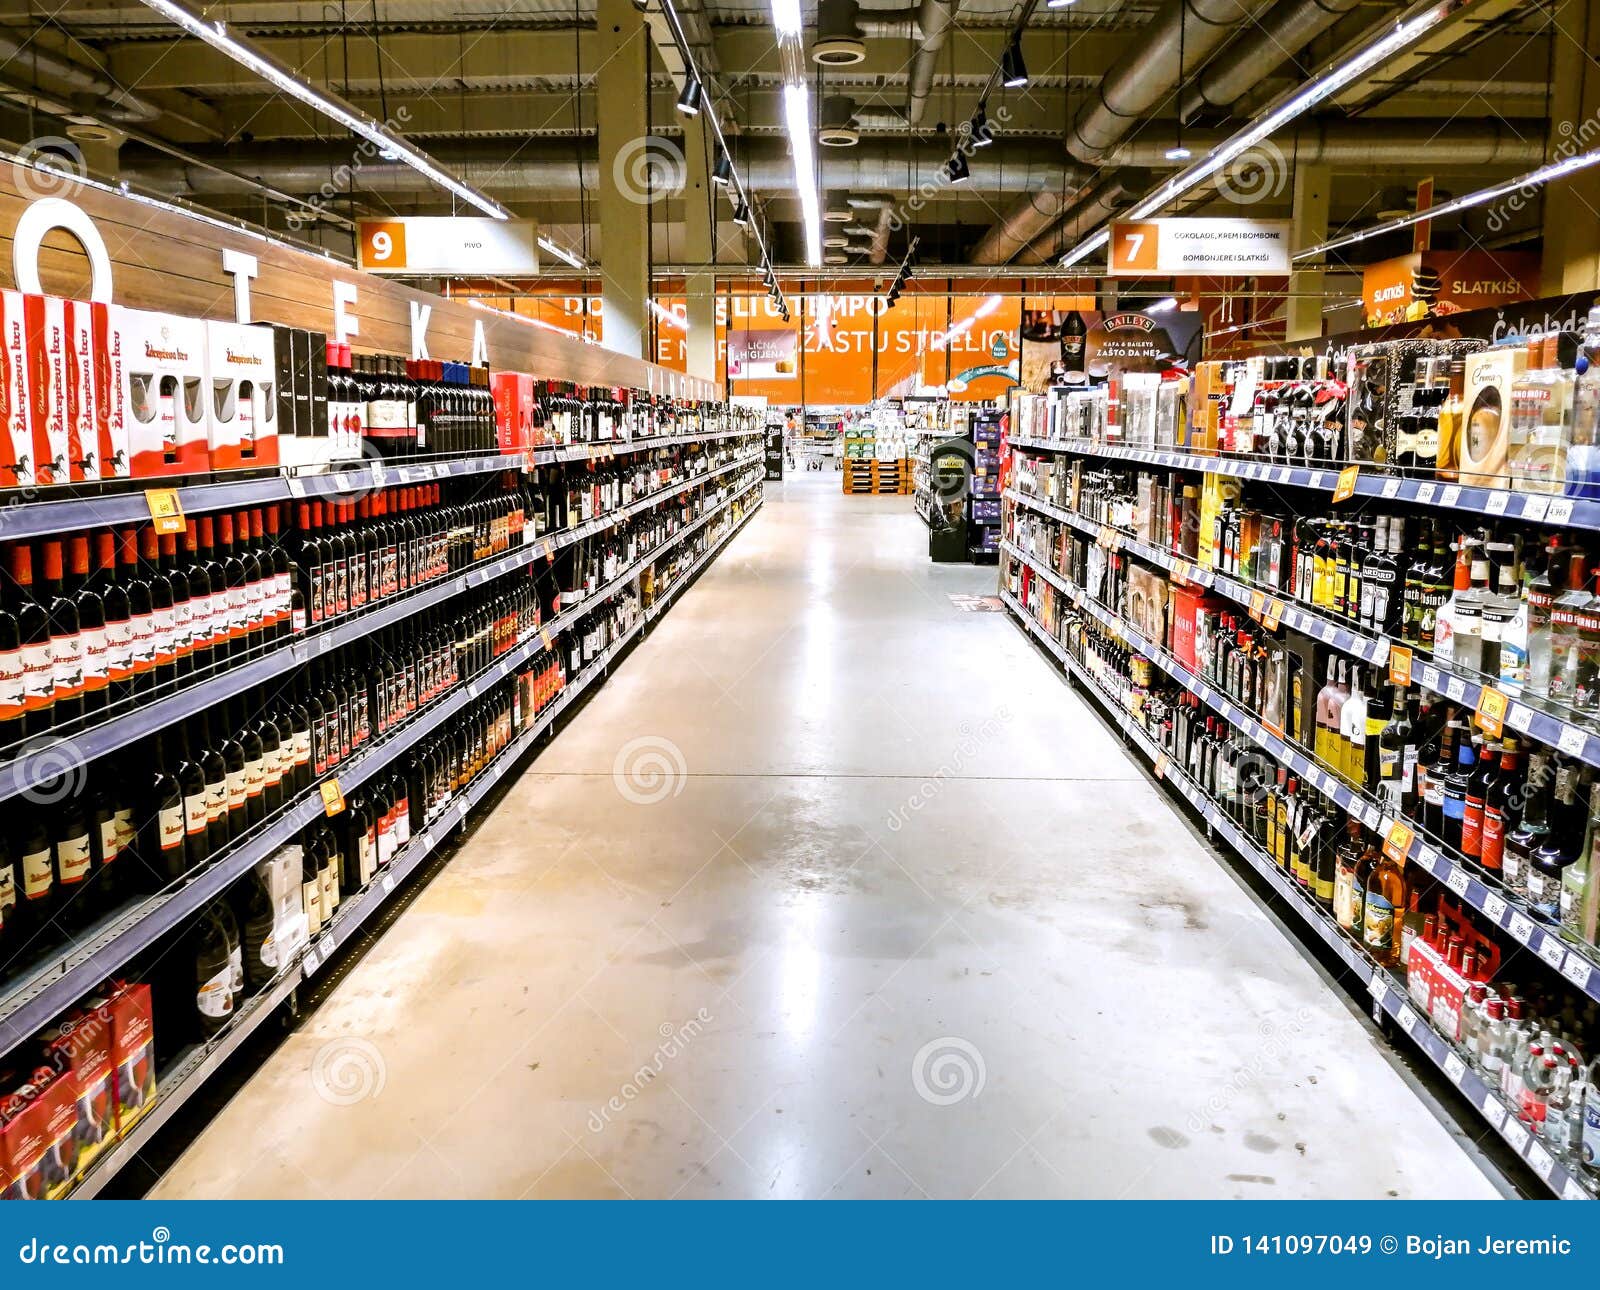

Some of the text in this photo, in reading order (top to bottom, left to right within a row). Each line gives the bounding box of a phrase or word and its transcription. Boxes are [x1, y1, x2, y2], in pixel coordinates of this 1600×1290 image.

[371, 231, 393, 260] 9
[1125, 234, 1144, 262] 7
[1374, 281, 1404, 302] SLATKIŠI
[1452, 279, 1521, 295] SLATKIŠI
[1106, 315, 1152, 329] BAILEYS
[1096, 348, 1160, 357] ZAŠTO DA NE?
